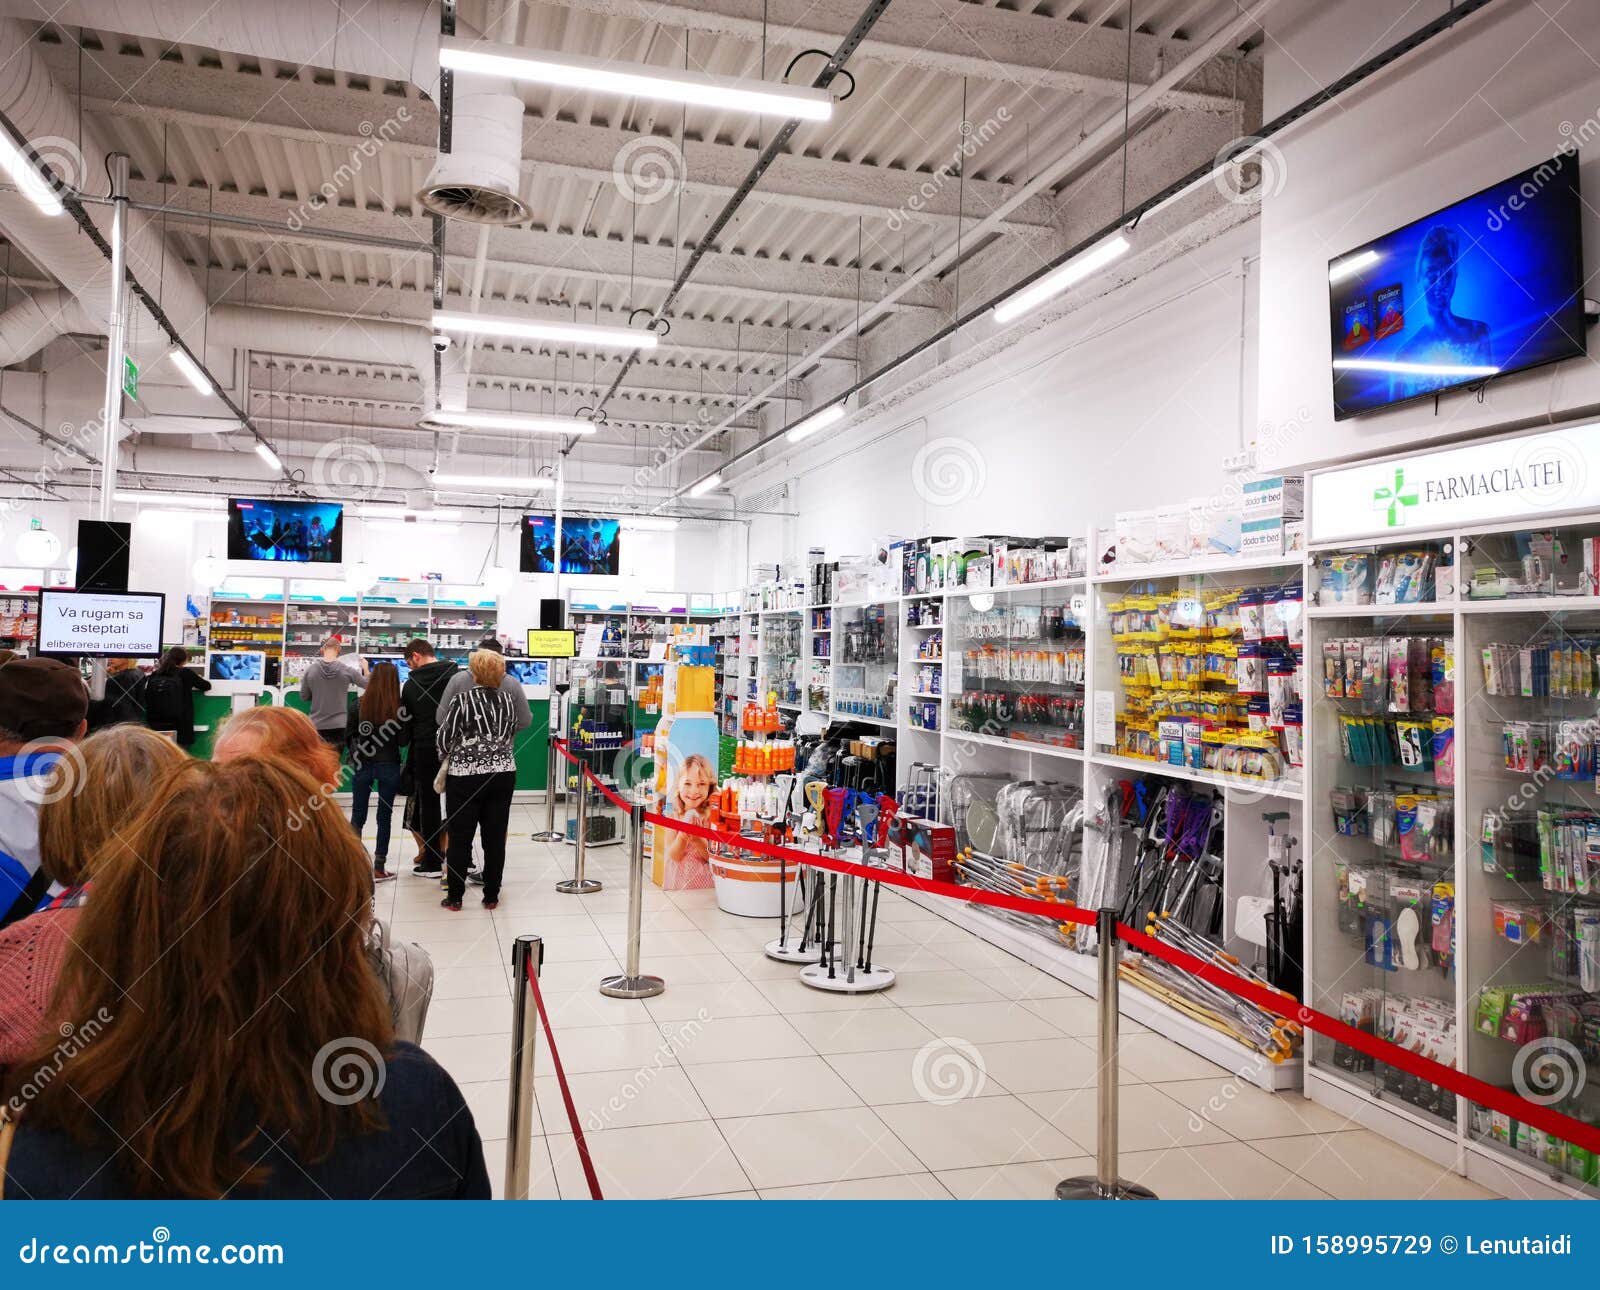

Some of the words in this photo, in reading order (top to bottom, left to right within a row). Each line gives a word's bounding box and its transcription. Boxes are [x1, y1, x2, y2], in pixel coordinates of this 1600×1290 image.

[1426, 468, 1524, 502] FARMACIA
[1529, 460, 1564, 487] TEI
[1268, 491, 1281, 502] bed
[1243, 536, 1259, 546] dodo
[1267, 533, 1280, 543] bed
[58, 607, 77, 618] Va
[81, 609, 124, 621] rugam
[128, 611, 144, 620] sa
[71, 623, 129, 635] asteptati
[46, 640, 100, 649] eliberarea
[128, 642, 153, 650] case
